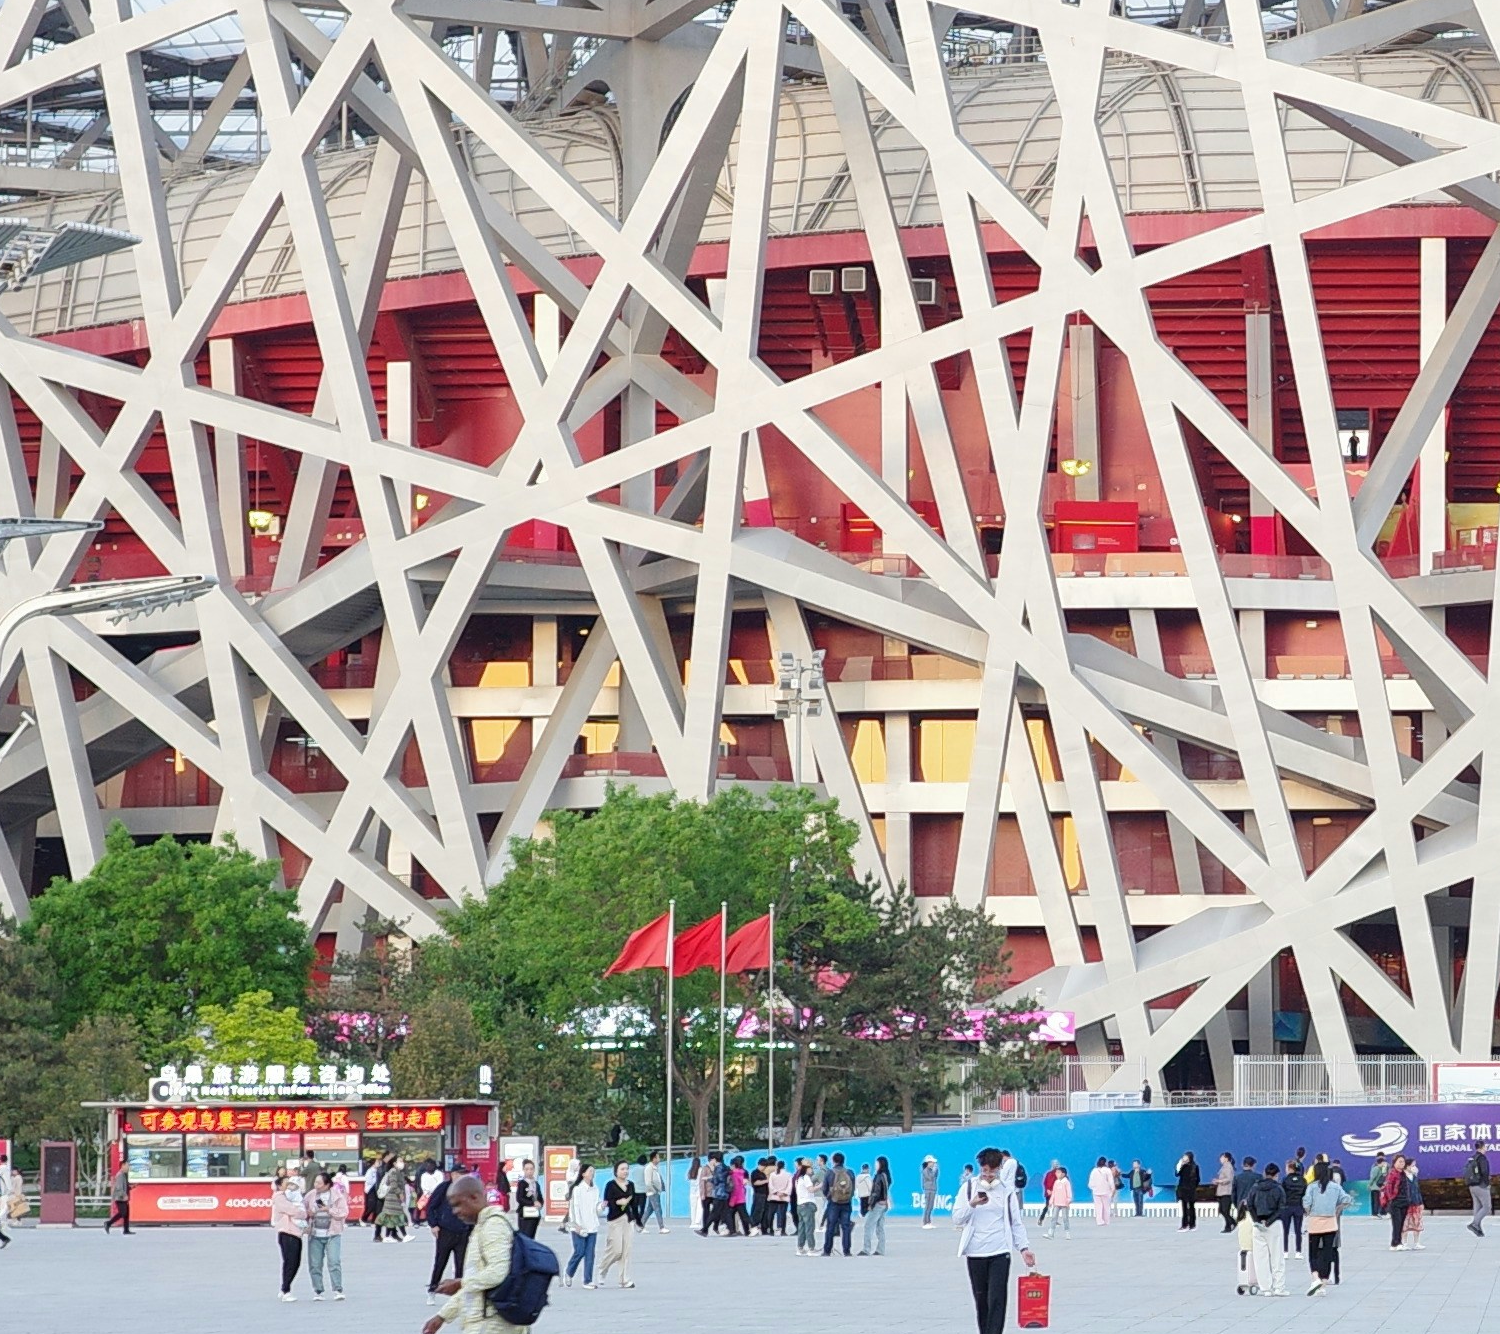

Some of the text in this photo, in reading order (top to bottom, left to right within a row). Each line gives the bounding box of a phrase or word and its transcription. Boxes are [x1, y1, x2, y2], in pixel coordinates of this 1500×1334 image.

[201, 1085, 229, 1096] Nest
[231, 1085, 275, 1096] Tourist
[278, 1084, 354, 1095] Information
[1419, 1143, 1473, 1153] NATIONAL
